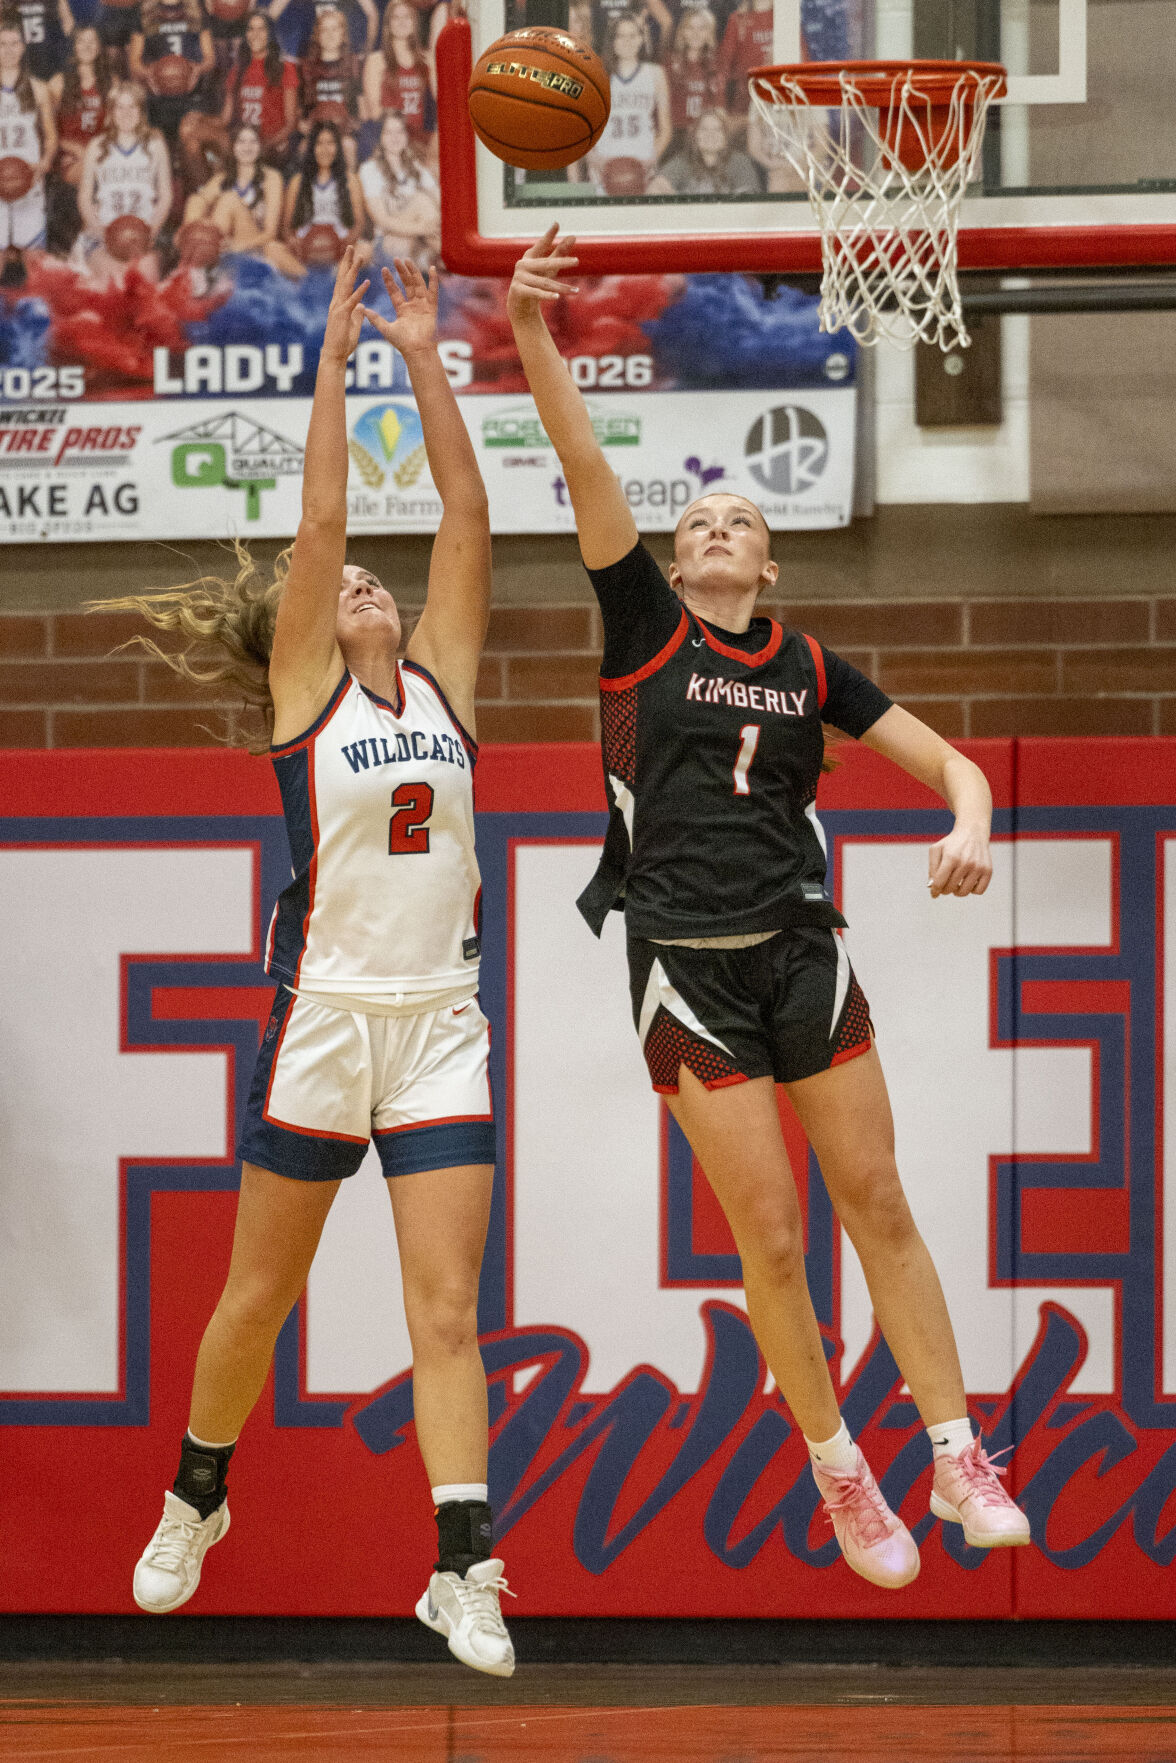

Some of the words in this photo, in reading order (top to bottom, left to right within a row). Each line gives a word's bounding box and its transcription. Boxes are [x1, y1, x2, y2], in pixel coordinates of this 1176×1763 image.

[486, 61, 547, 88] ELITE
[550, 72, 584, 99] PRO
[0, 366, 85, 399] 025
[153, 343, 303, 394] LADY
[344, 339, 473, 389] AS
[563, 353, 653, 388] 026
[55, 425, 142, 467] PROS
[85, 483, 139, 515] AG
[384, 494, 443, 516] Farm
[686, 672, 808, 717] KIMBERLY
[340, 731, 465, 774] WILDCATS
[732, 723, 761, 796] 1
[388, 781, 435, 856] 2
[352, 1299, 1176, 1576] Wildc
